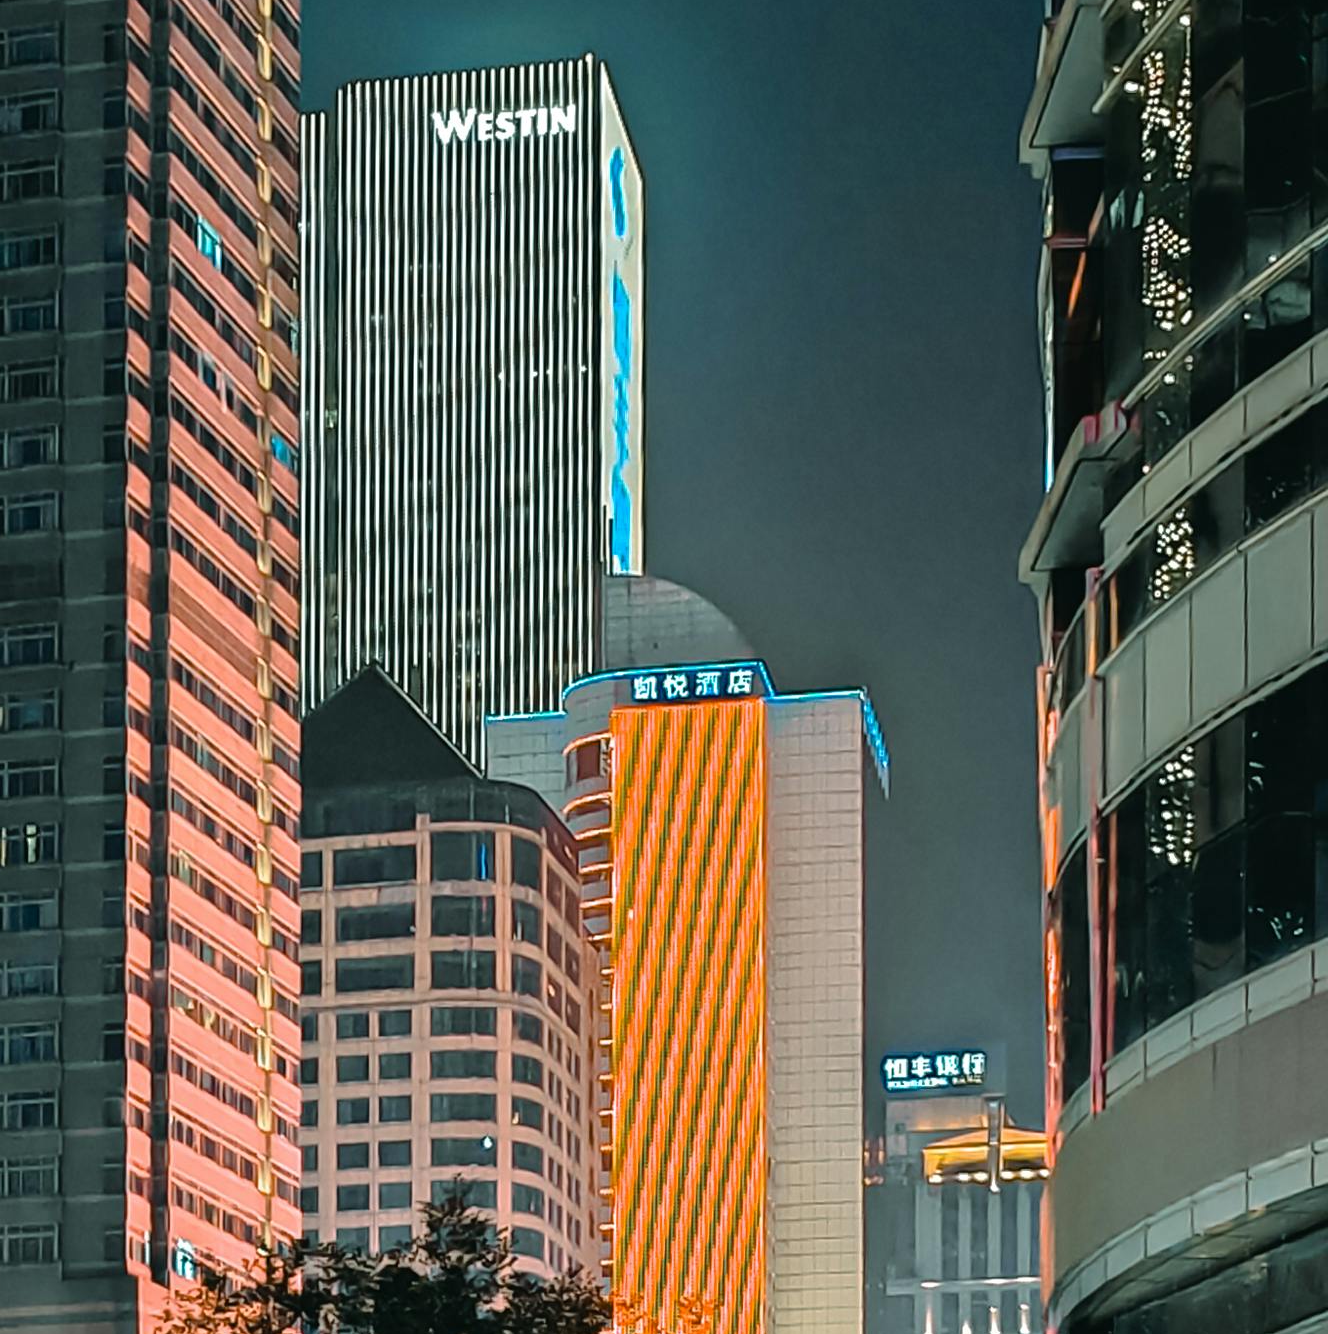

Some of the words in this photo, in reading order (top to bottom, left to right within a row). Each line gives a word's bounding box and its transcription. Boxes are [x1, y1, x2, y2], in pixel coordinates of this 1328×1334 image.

[431, 104, 576, 145] WESTIN
[633, 668, 753, 700] 凯悦酒店
